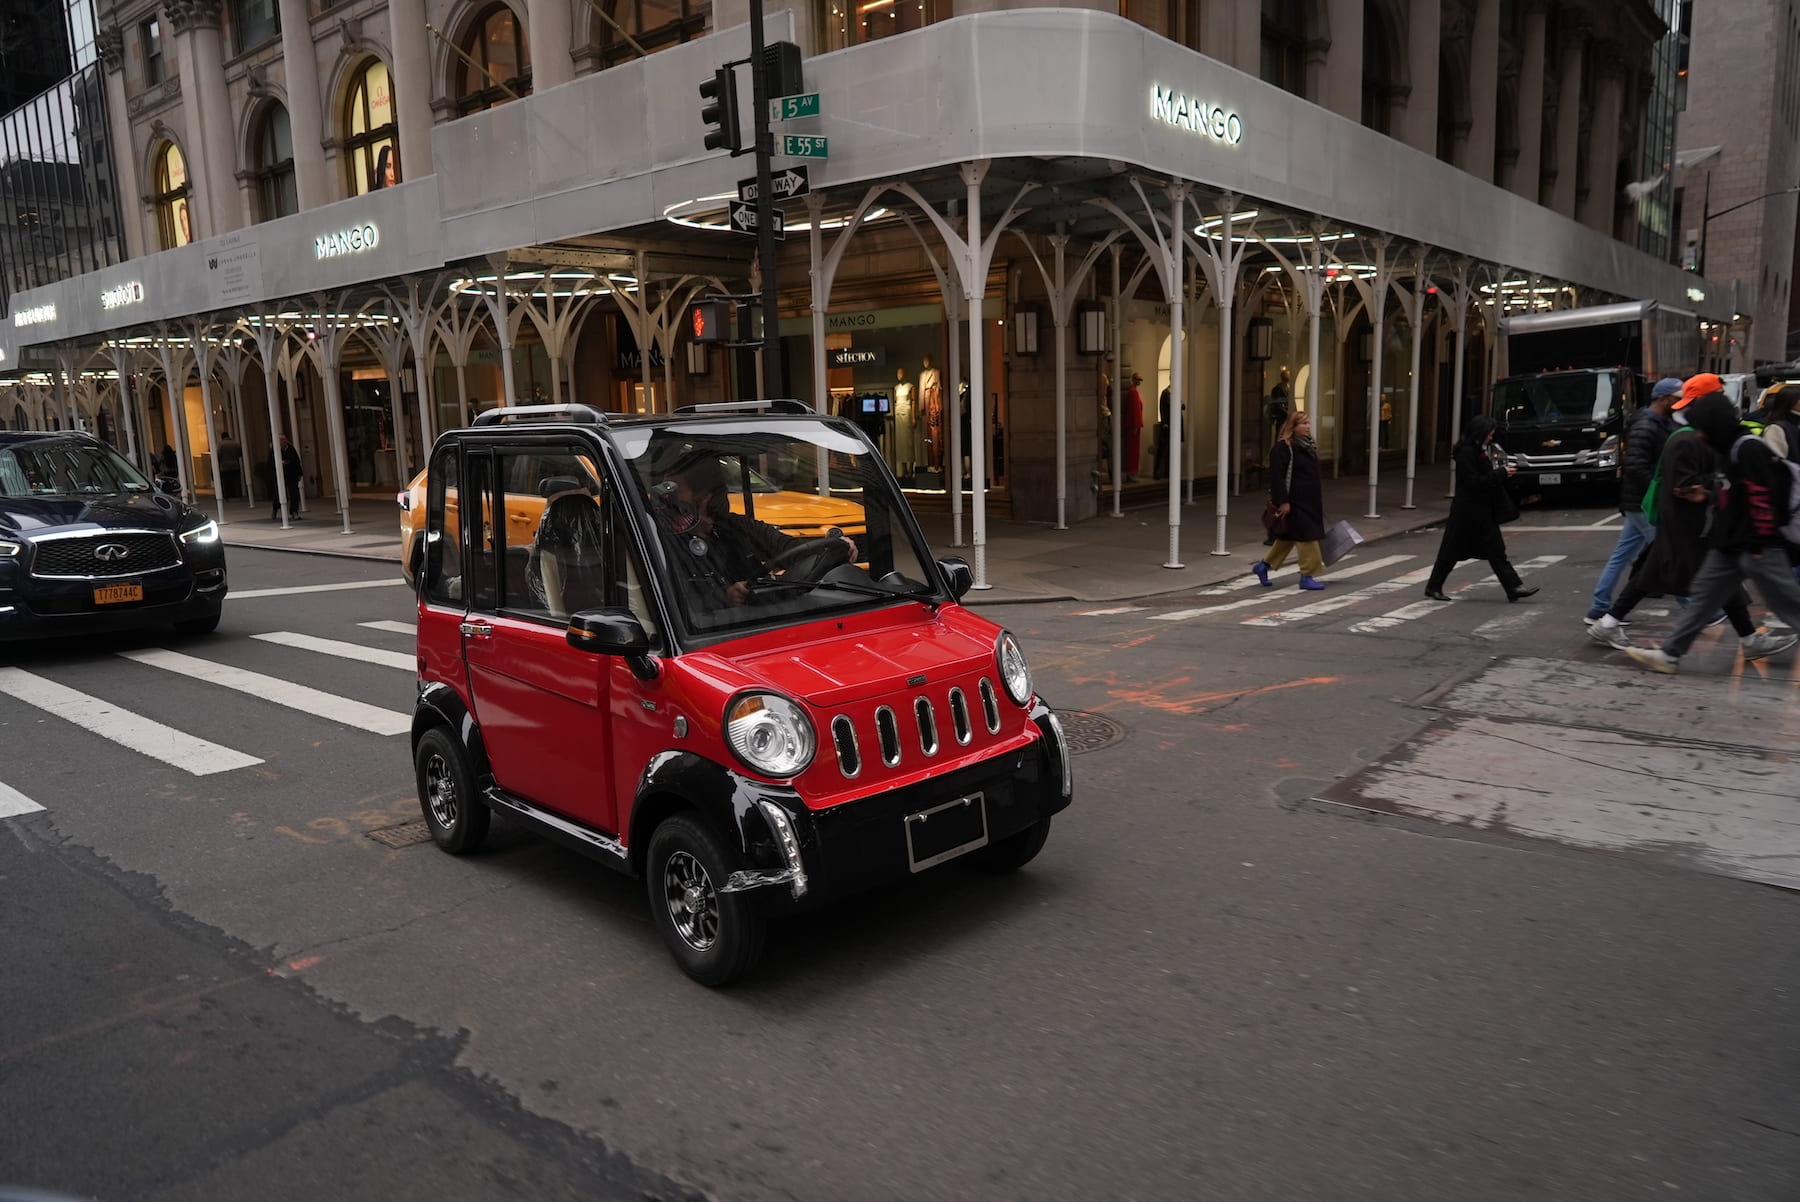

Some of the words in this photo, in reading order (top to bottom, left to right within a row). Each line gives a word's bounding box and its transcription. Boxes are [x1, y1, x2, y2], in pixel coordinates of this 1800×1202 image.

[788, 98, 799, 118] 5
[802, 95, 814, 107] AV
[1151, 84, 1243, 145] MANGO
[786, 136, 794, 155] E
[797, 137, 812, 155] 55
[815, 138, 825, 149] ST
[747, 185, 758, 198] ON
[774, 176, 797, 192] WAY
[738, 211, 756, 225] ONE
[314, 224, 379, 260] MANGO
[829, 313, 876, 328] MANGO
[99, 587, 137, 601] T778744C
